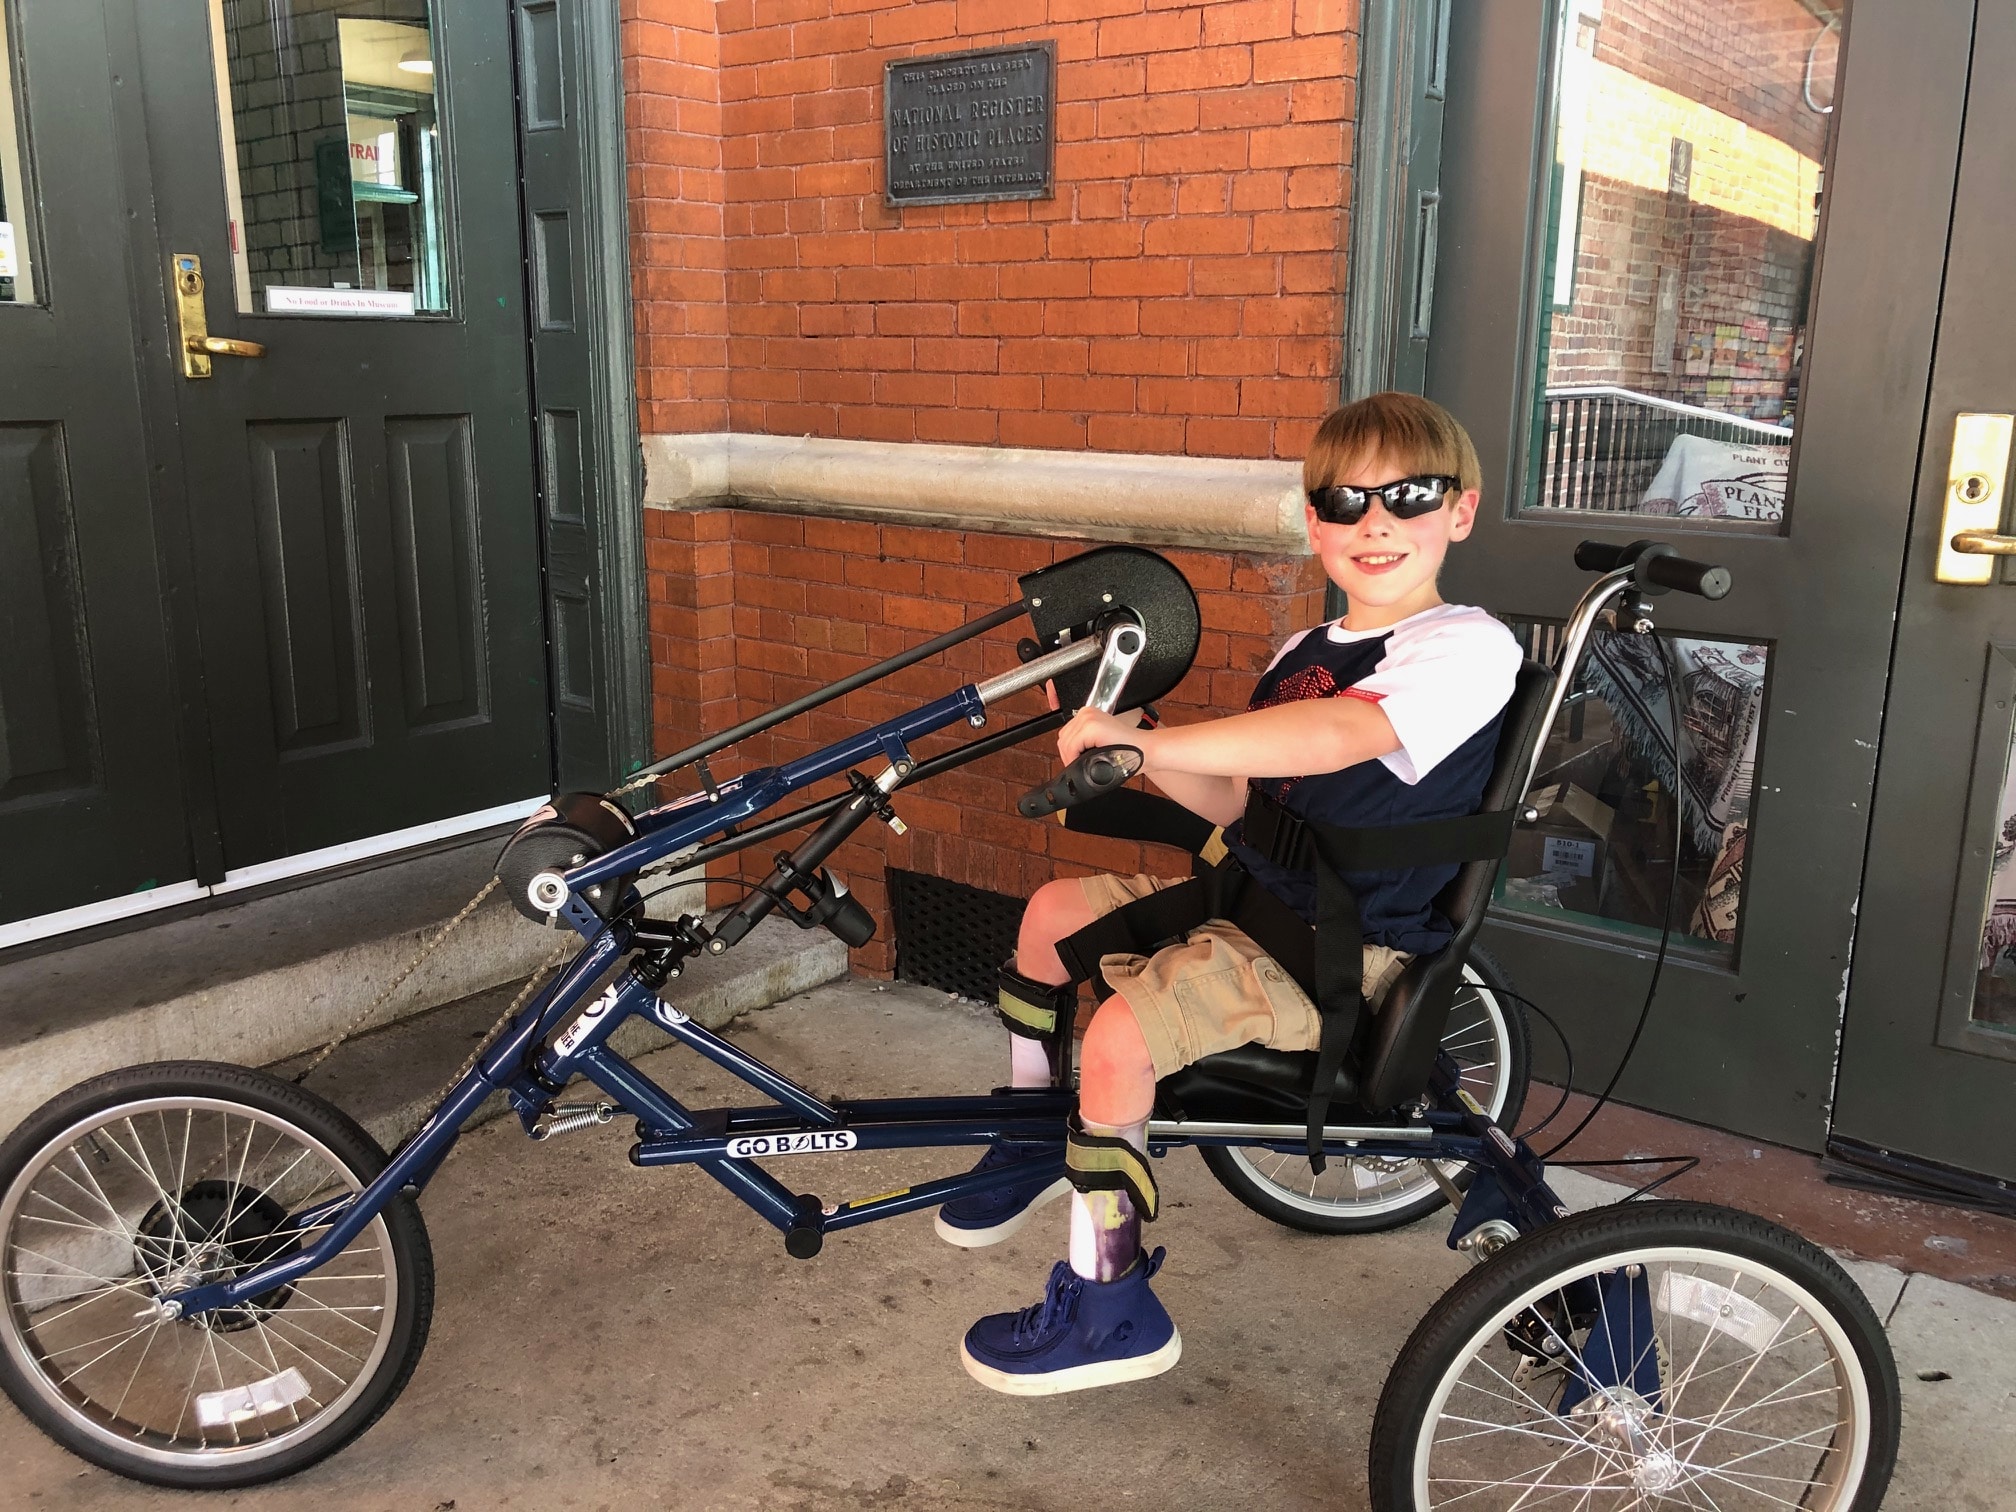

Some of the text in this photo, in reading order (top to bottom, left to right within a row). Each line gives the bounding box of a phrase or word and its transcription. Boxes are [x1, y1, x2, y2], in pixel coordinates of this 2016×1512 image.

[892, 95, 1045, 128] NATIONAL REGISTER
[892, 123, 1044, 154] OF HISTORIC PLACES
[286, 297, 297, 305] No
[299, 297, 318, 306] Food
[330, 299, 356, 307] Drinks
[367, 300, 398, 309] Museum
[1732, 453, 1767, 466] PLANT
[736, 1138, 770, 1155] GO
